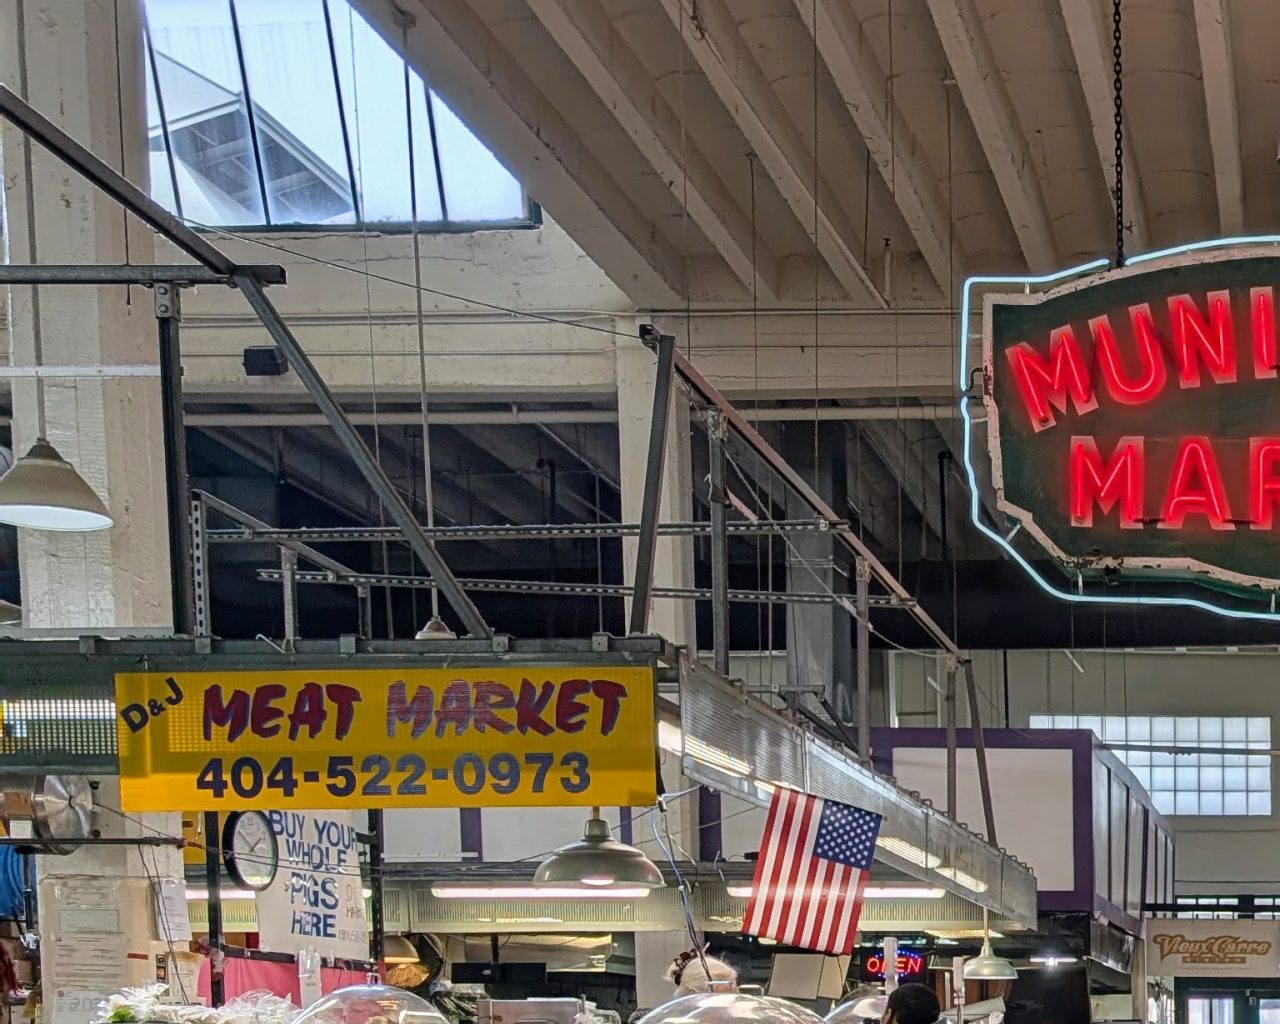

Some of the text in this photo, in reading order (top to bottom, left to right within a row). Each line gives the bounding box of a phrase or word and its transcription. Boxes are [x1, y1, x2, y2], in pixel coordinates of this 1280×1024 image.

[119, 676, 185, 733] D&J
[203, 677, 627, 743] MEAT MARKET
[196, 751, 591, 799] 404-522-0973
[268, 809, 306, 839] BUY
[285, 838, 348, 873] WHOLE
[290, 871, 340, 911] PIGS
[290, 909, 337, 939] HERE
[1153, 933, 1213, 965] Vieux
